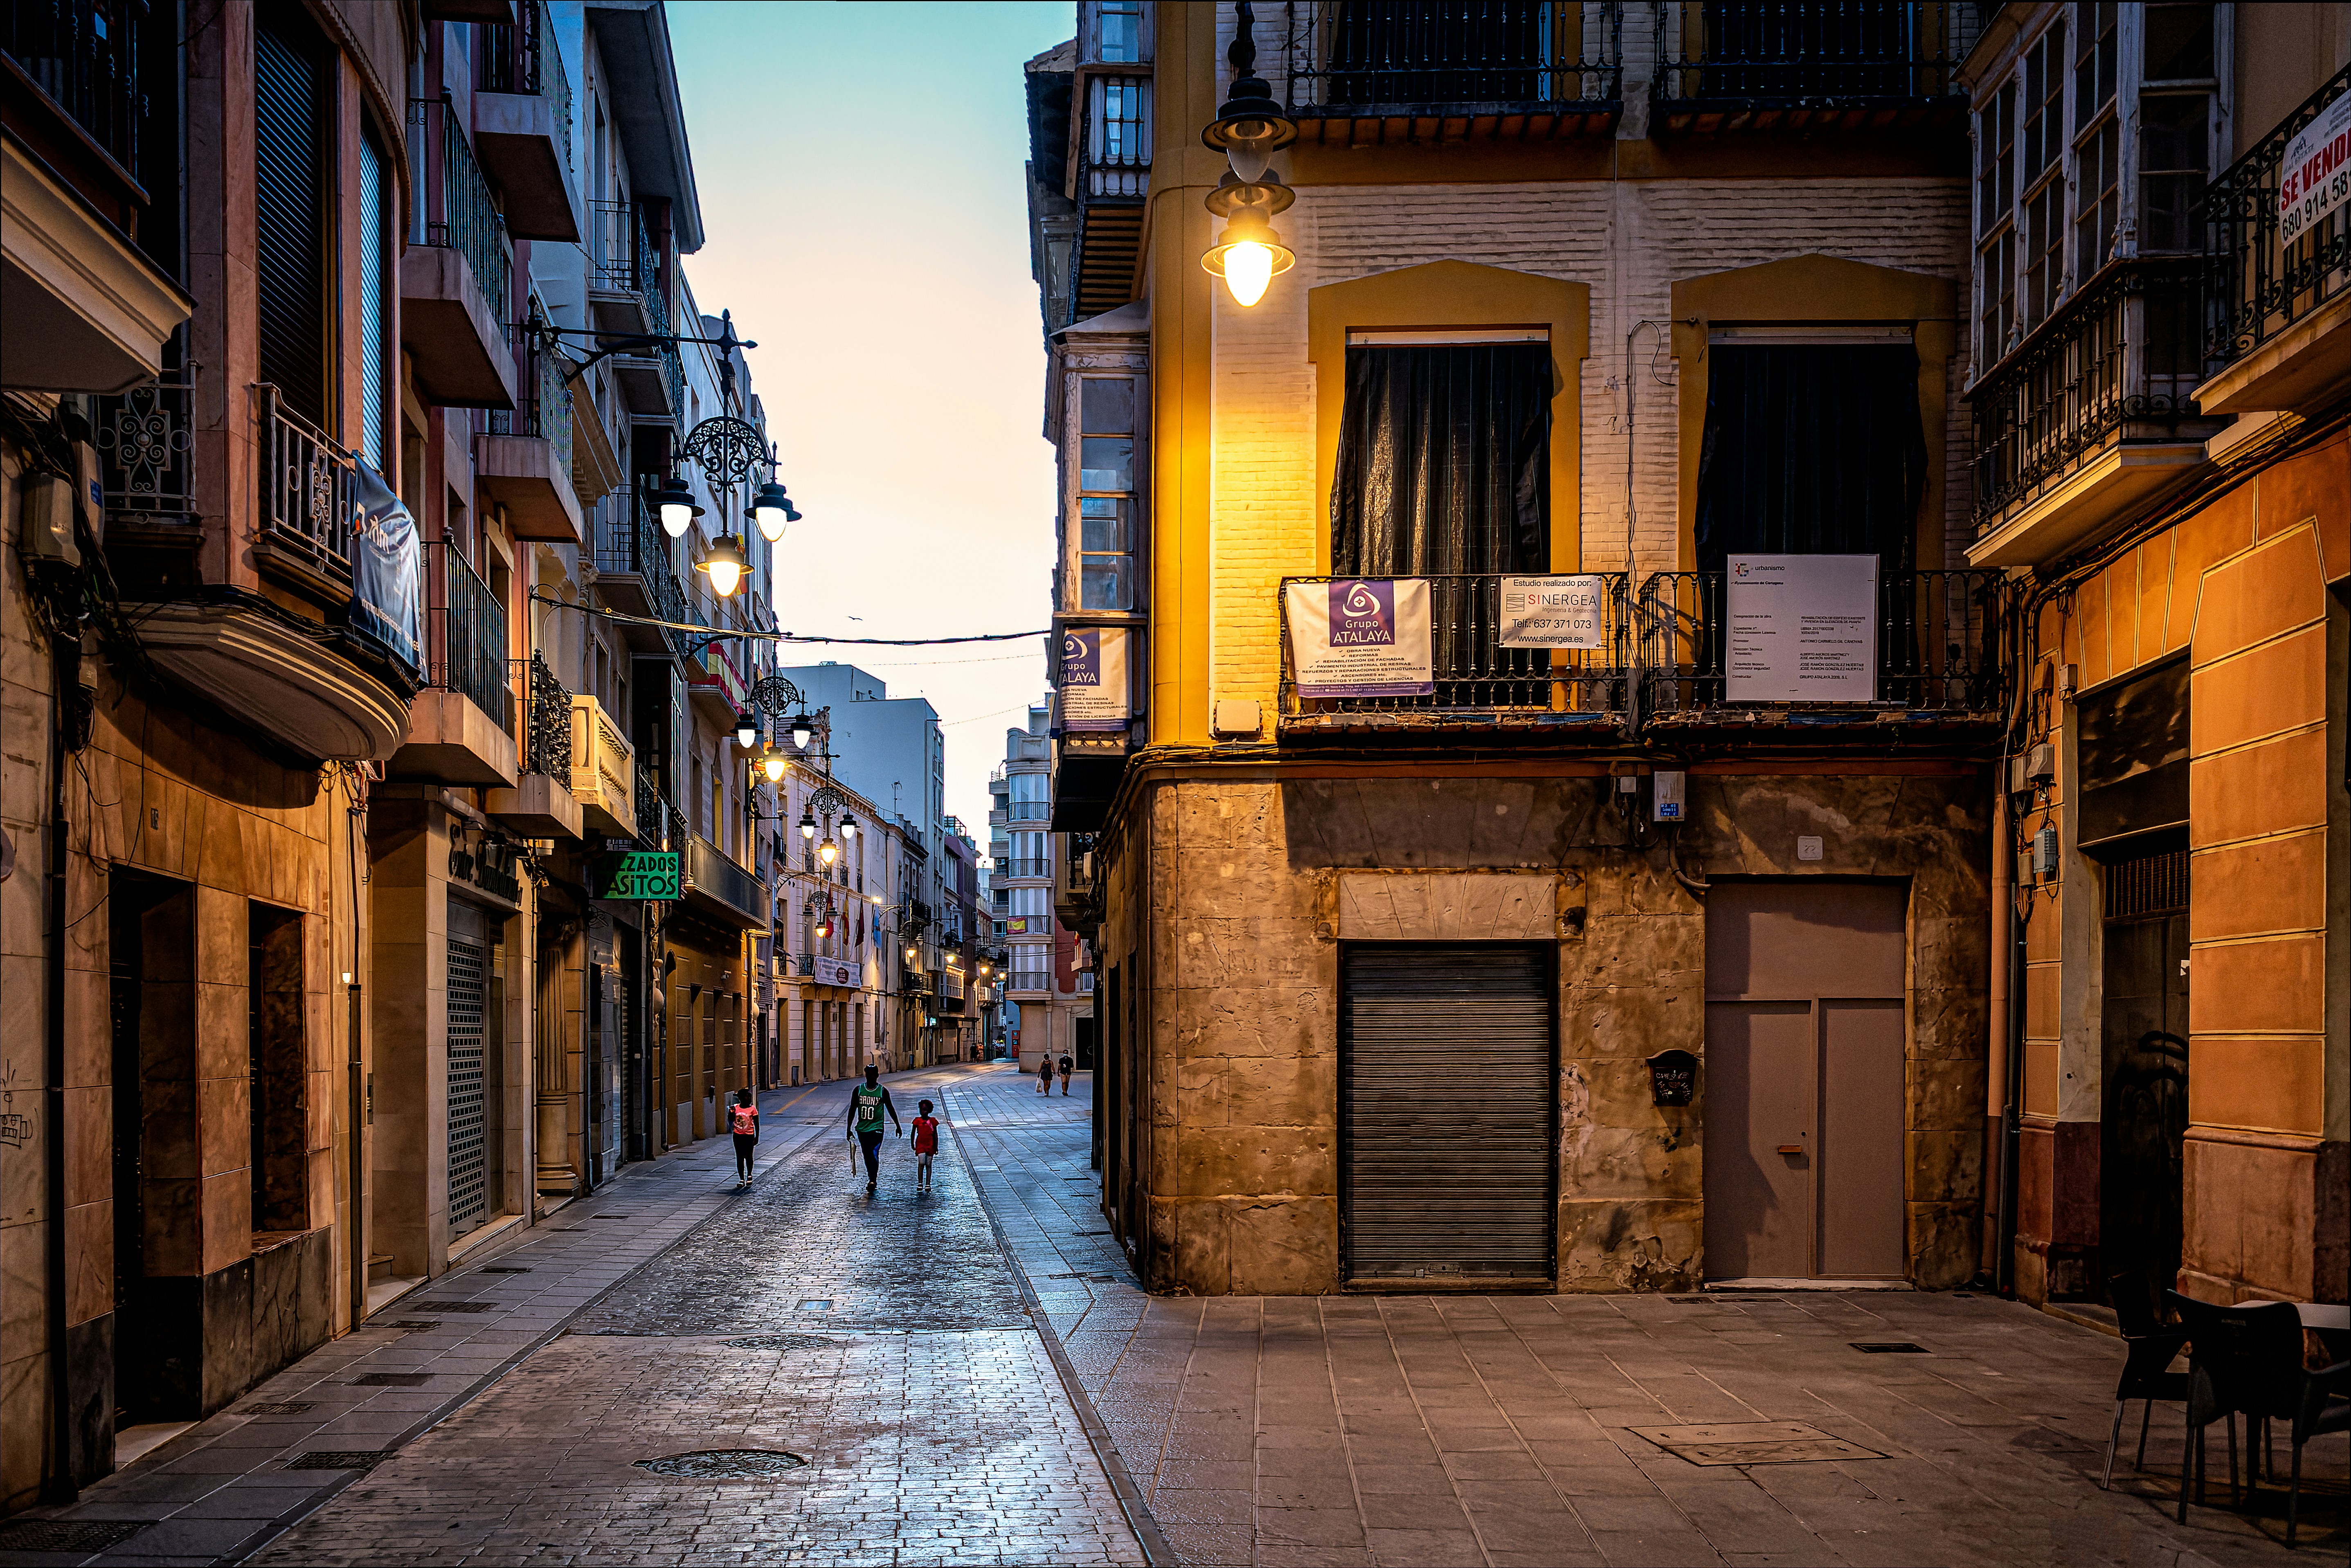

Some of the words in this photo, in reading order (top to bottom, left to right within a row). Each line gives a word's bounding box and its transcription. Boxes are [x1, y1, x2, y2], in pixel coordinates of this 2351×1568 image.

[2281, 170, 2298, 211] SE
[2282, 207, 2301, 241] 680
[2305, 186, 2328, 223] 914
[2332, 171, 2351, 202] 58
[1528, 594, 1597, 606] SINERGEA
[1345, 620, 1378, 630] Grupo
[1534, 619, 1551, 628] 637
[1554, 620, 1570, 628] 371
[1574, 620, 1591, 629] 073
[1333, 630, 1391, 643] ATALAYA
[1518, 634, 1584, 644] www.sinergea.es
[1062, 672, 1096, 683] ALAYA
[598, 856, 676, 872] LZADOS
[862, 1106, 874, 1120] 00
